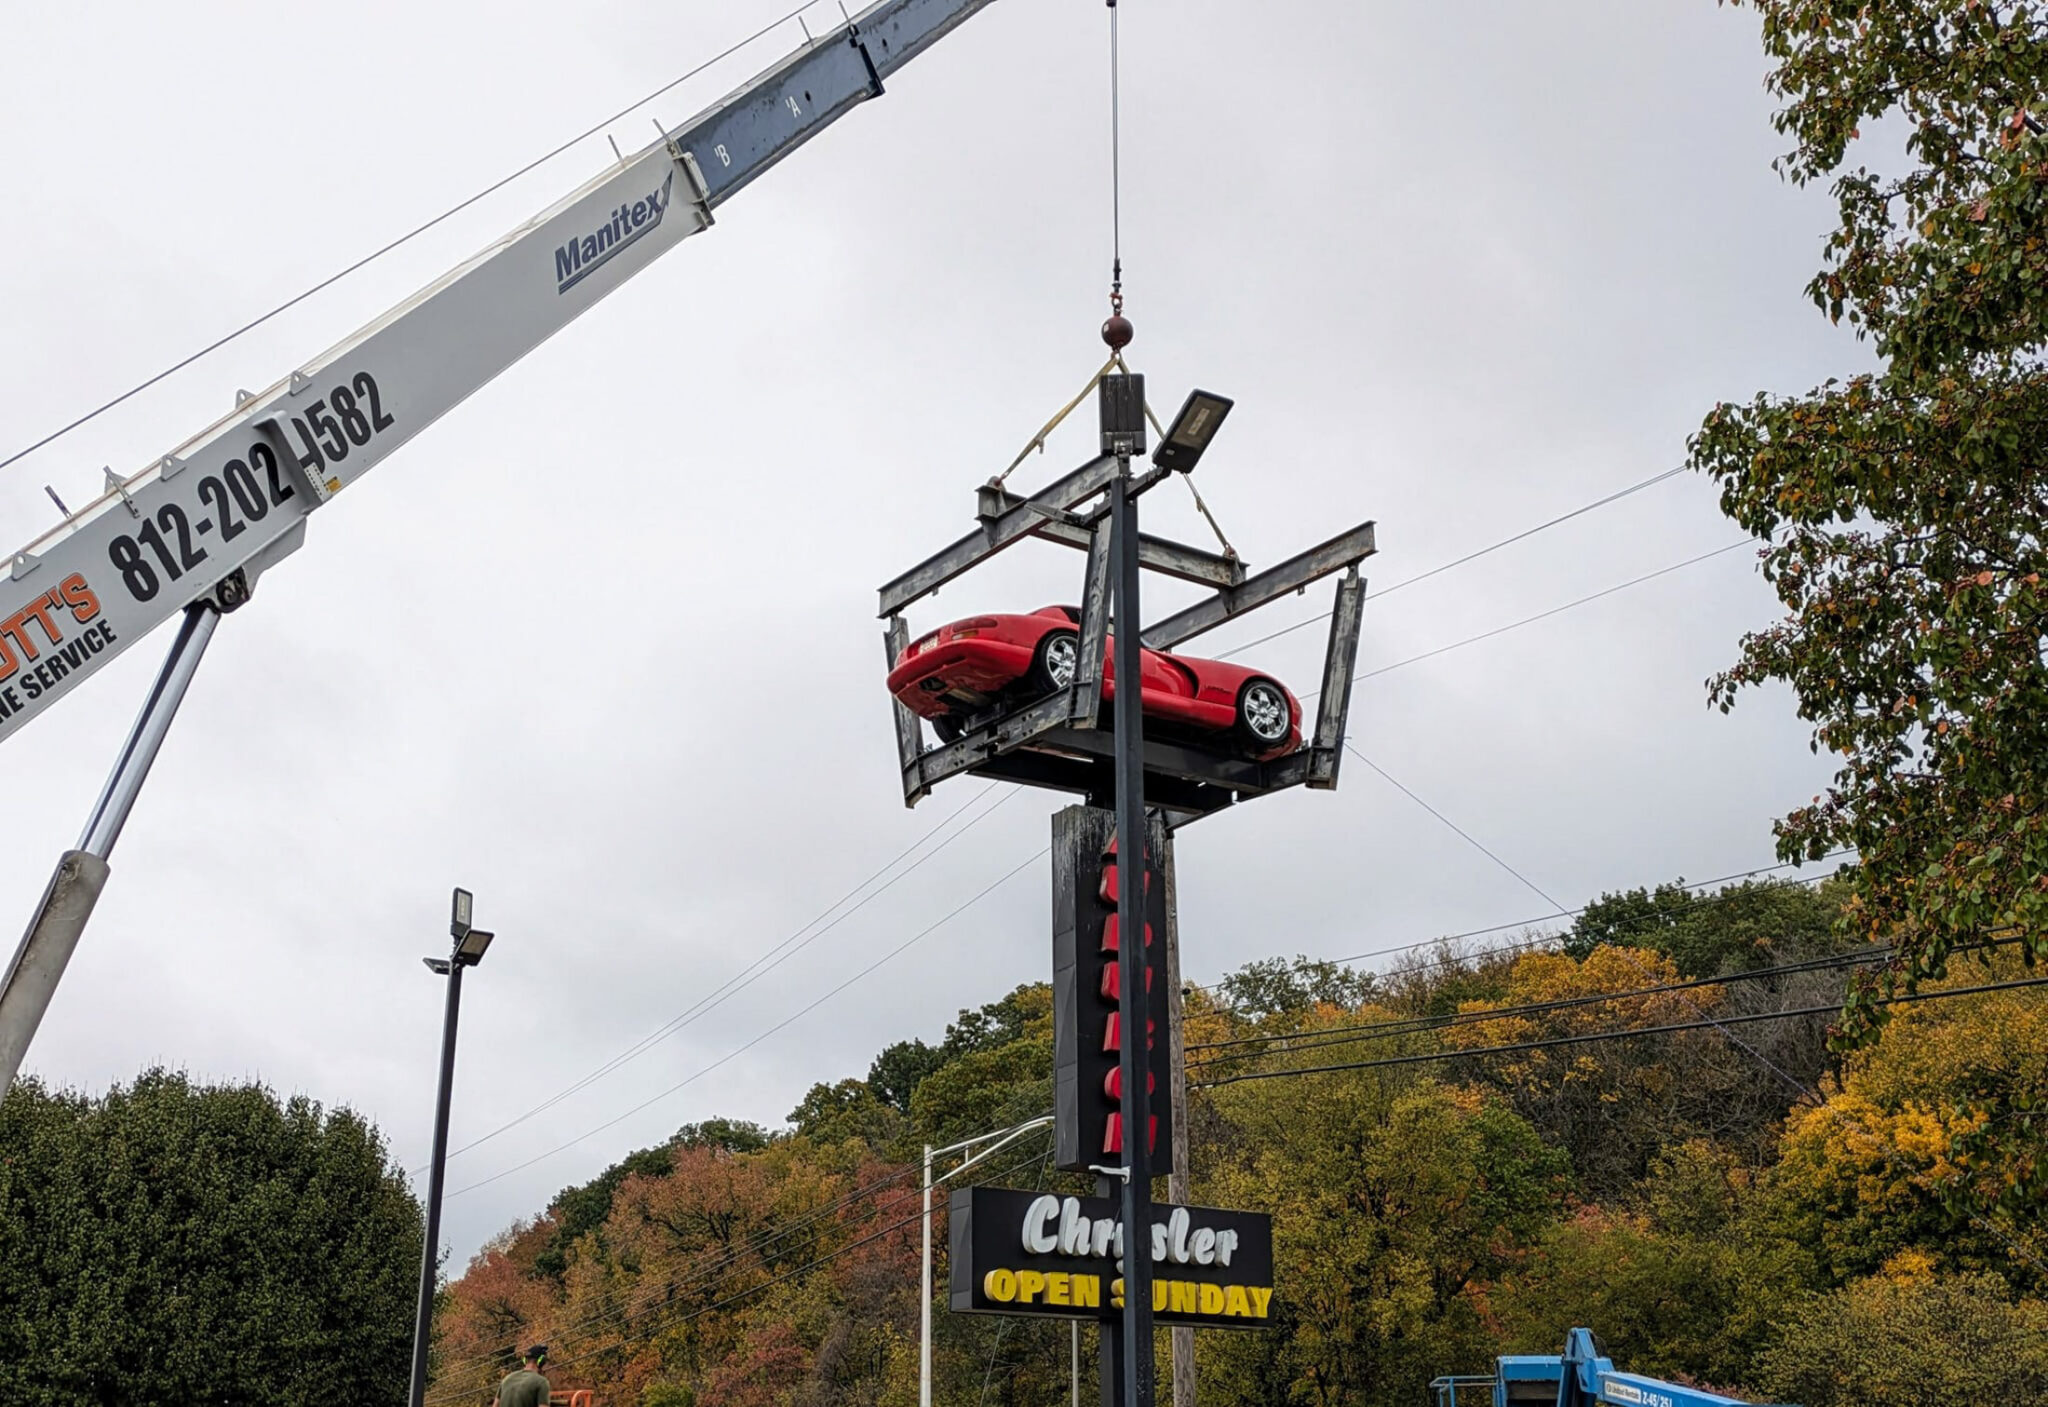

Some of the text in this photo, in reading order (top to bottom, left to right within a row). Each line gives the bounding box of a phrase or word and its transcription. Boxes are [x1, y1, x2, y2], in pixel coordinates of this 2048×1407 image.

[555, 188, 662, 282] Manitex
[20, 619, 117, 700] SERVICE
[1022, 1194, 1239, 1274] Chrsler
[983, 1267, 1101, 1308] OPEN
